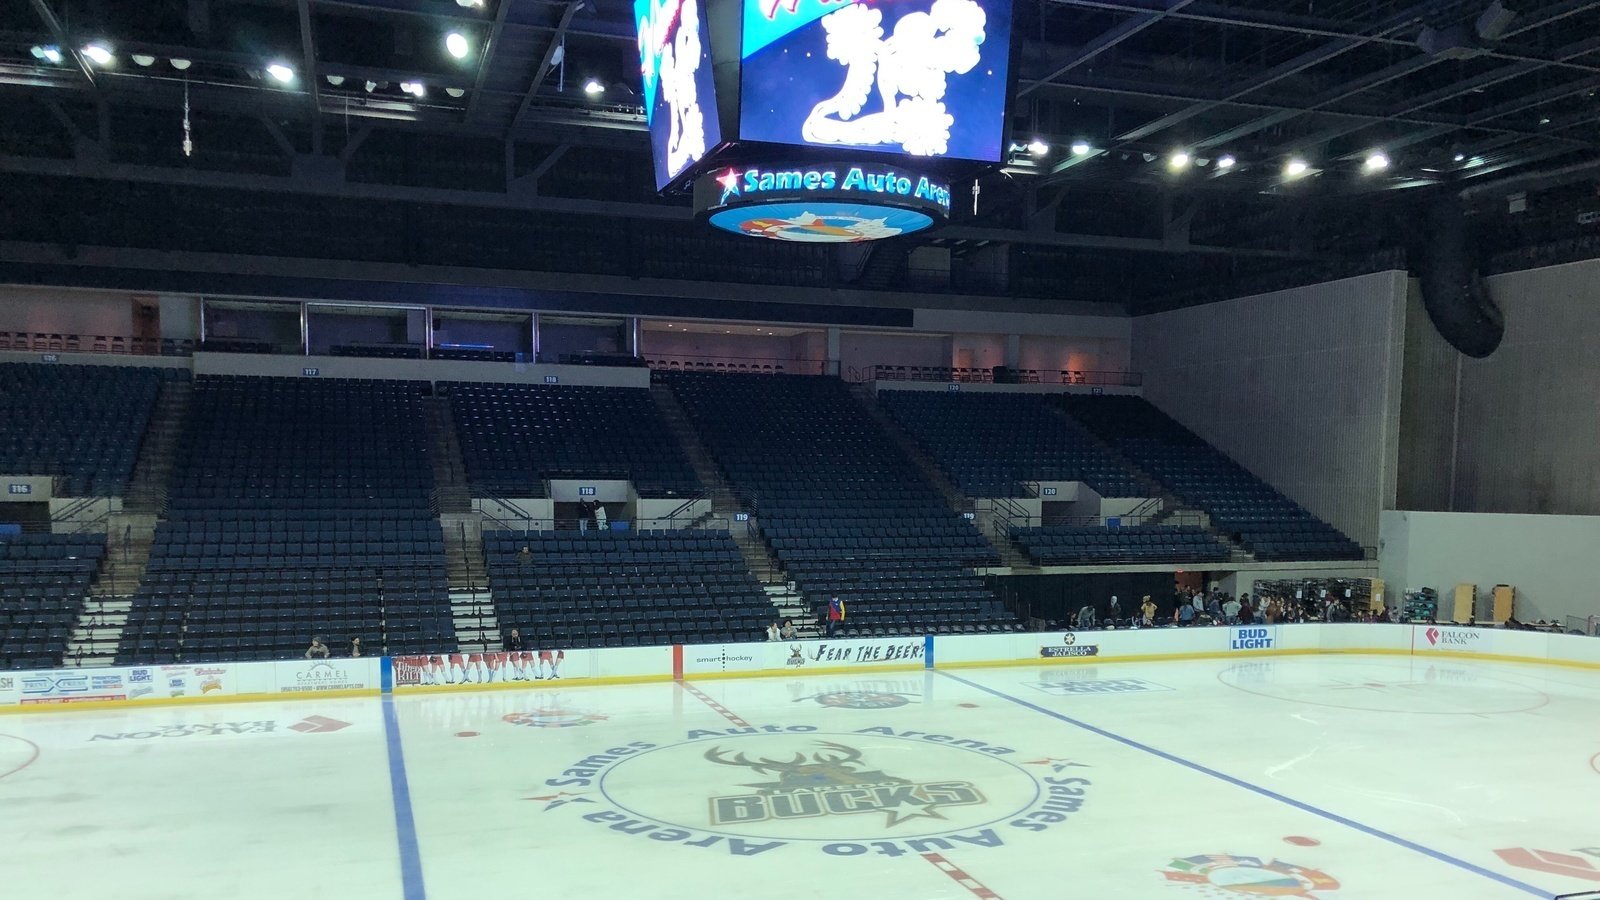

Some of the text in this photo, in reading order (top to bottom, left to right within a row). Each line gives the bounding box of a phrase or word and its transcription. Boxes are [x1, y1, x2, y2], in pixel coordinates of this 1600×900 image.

[743, 167, 950, 210] Sames Auto Aren
[581, 487, 594, 495] 118
[736, 513, 749, 521] 119
[963, 512, 975, 520] 119
[1238, 628, 1268, 639] BUD
[1441, 630, 1480, 640] FALCON
[1232, 638, 1273, 650] LIGHT
[815, 644, 852, 662] FEAR
[856, 645, 882, 662] THE
[296, 670, 348, 679] CARMEL
[545, 725, 1016, 786] Sames Auto Arena
[708, 780, 988, 826] BUCKS
[582, 776, 1092, 857] Sames Auto Arena
